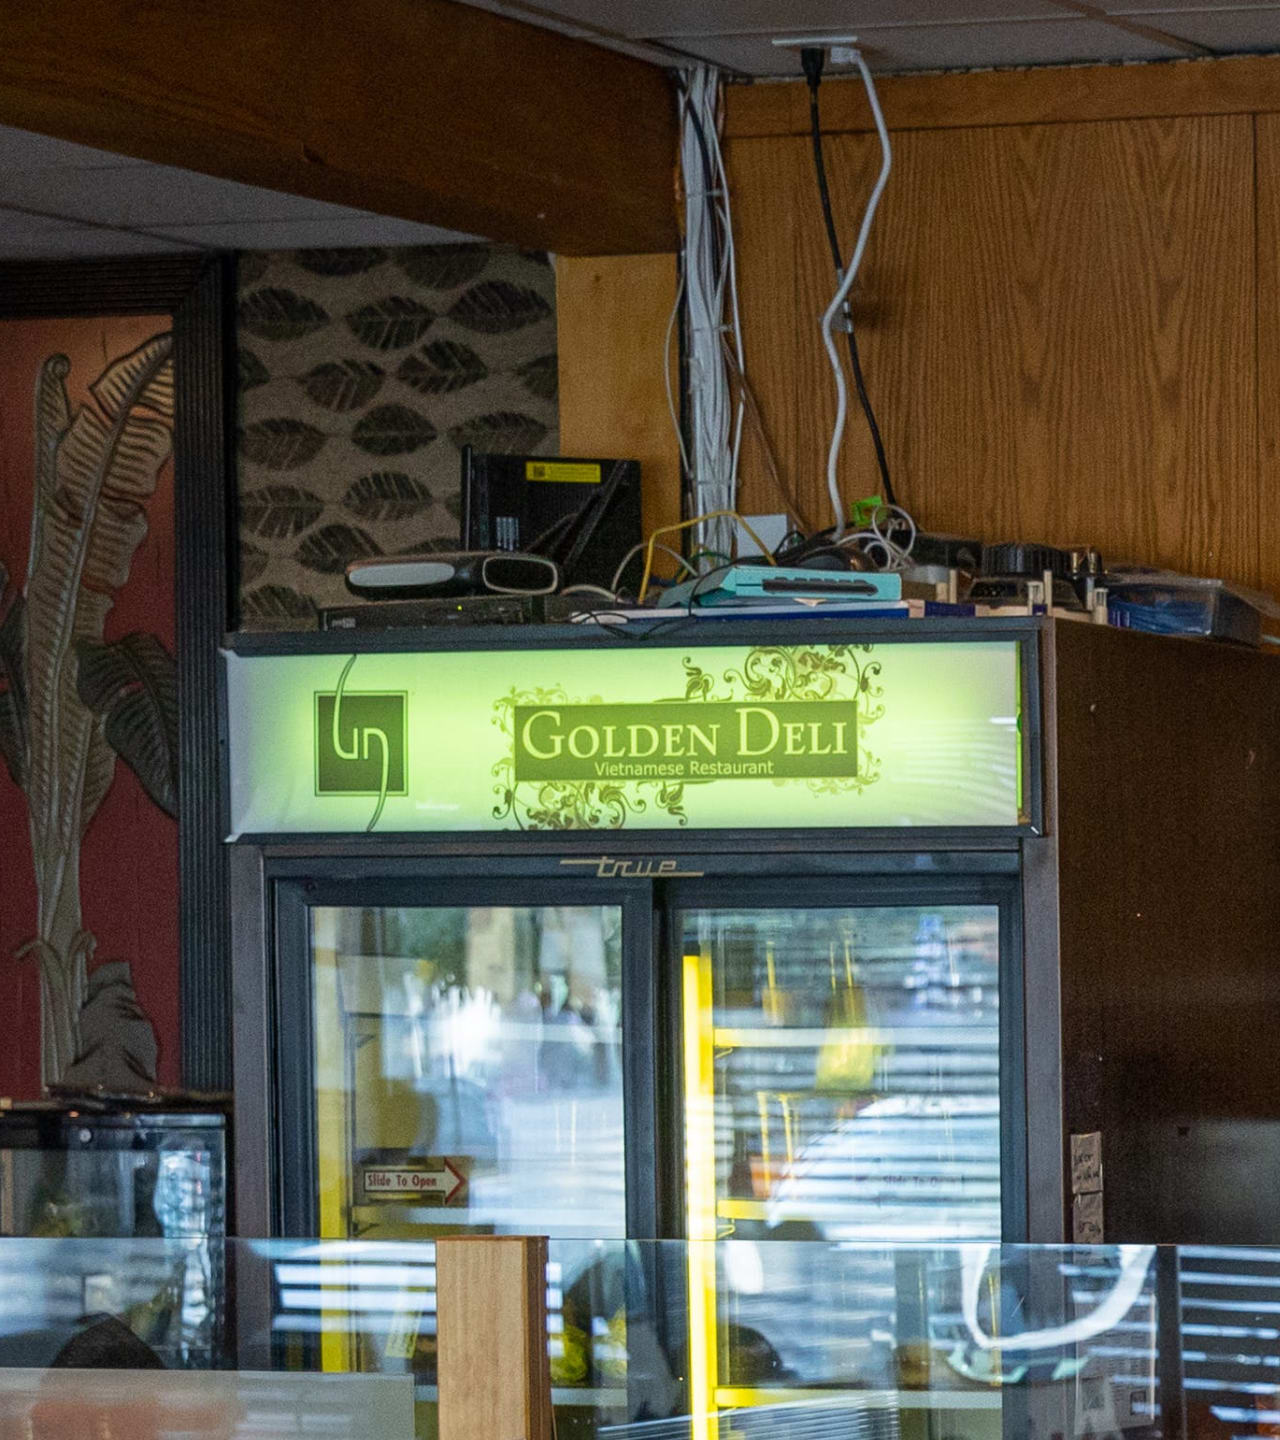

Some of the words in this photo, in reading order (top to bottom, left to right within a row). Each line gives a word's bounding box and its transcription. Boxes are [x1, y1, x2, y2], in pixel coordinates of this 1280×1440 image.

[522, 709, 720, 759] GOLDEN
[735, 707, 848, 756] DELI
[595, 761, 684, 777] Vietnamese
[690, 760, 774, 775] Restaurant
[560, 856, 704, 878] true
[367, 1172, 391, 1187] Slide
[396, 1174, 408, 1187] To
[412, 1174, 437, 1189] Open
